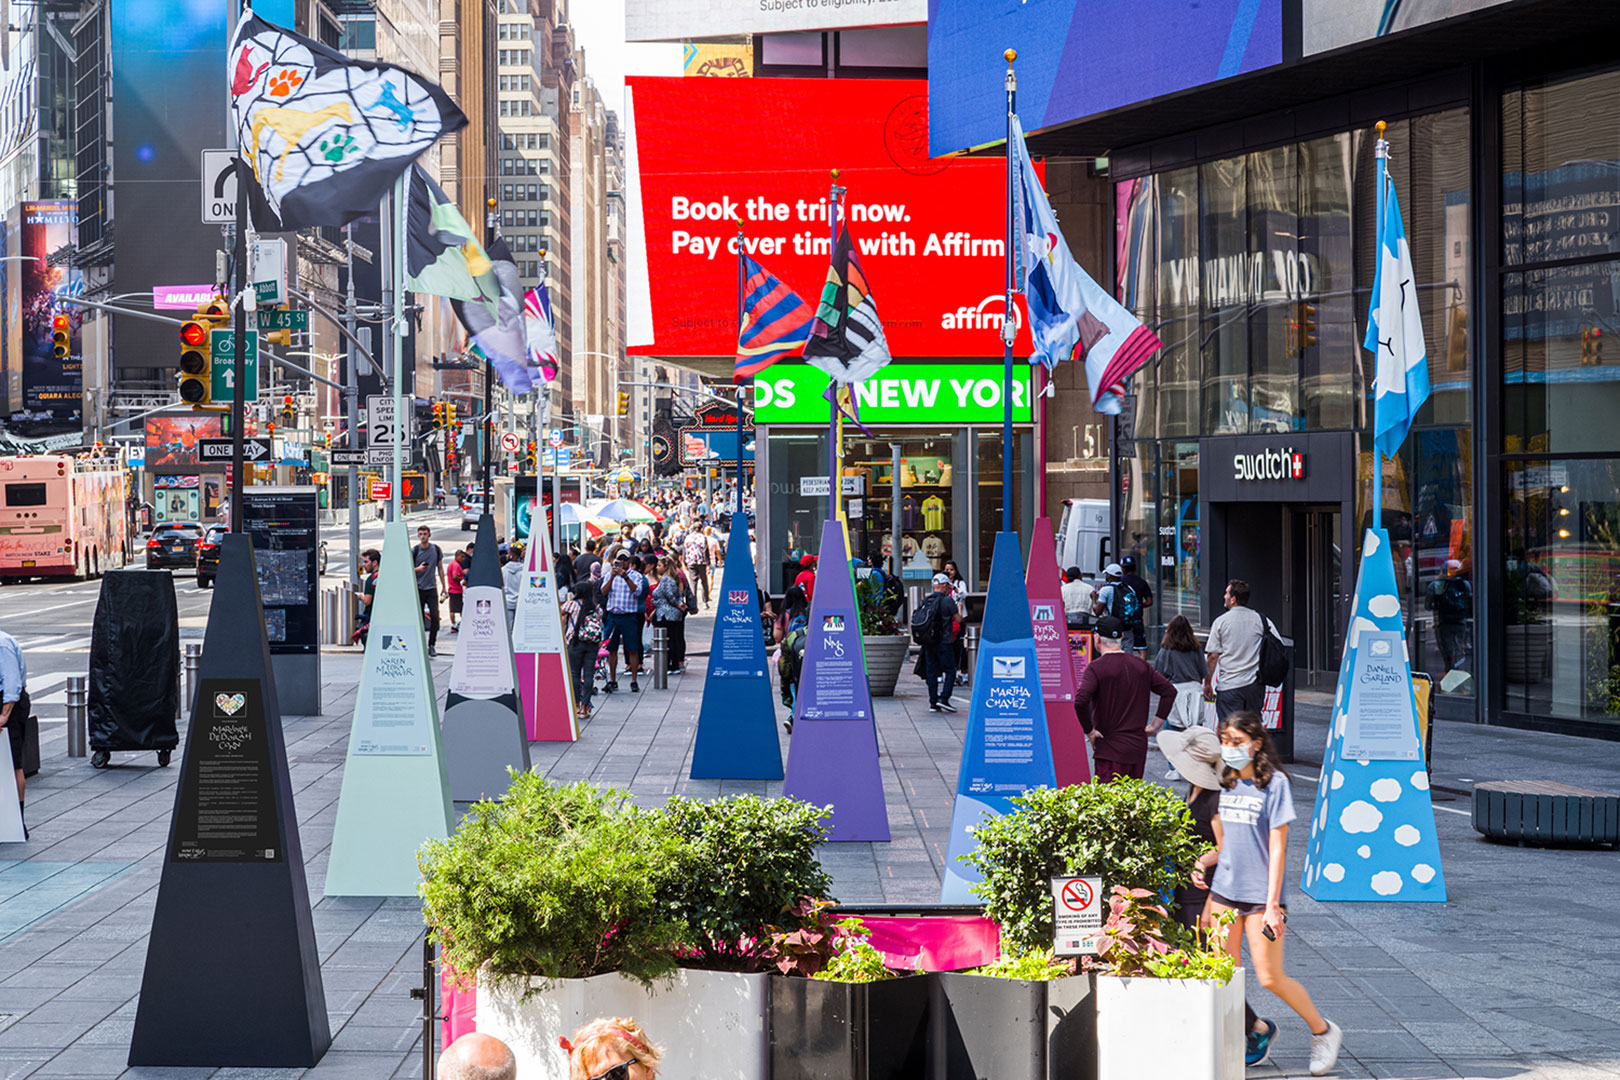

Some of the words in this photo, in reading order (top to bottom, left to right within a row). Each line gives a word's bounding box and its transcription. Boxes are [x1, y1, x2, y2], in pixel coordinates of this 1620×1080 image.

[760, 0, 803, 12] Subject
[807, 0, 818, 8] to
[672, 196, 738, 220] Book
[746, 196, 790, 221] the
[796, 197, 844, 226] trip
[851, 203, 911, 222] now.
[672, 231, 721, 260] Pay
[793, 231, 832, 255] tim
[859, 232, 916, 256] with
[923, 232, 1005, 257] Affirm
[260, 313, 271, 327] W
[277, 313, 291, 328] 45
[296, 313, 305, 322] St
[214, 356, 254, 367] Broaay
[855, 379, 941, 408] NEW
[949, 379, 1032, 408] YOR
[209, 446, 230, 455] ONE
[1234, 447, 1293, 480] swatch
[1367, 664, 1398, 675] DANIEL
[1360, 673, 1402, 685] GARLAND
[991, 686, 1031, 698] MARTHA
[985, 698, 1027, 709] CHAVEZ
